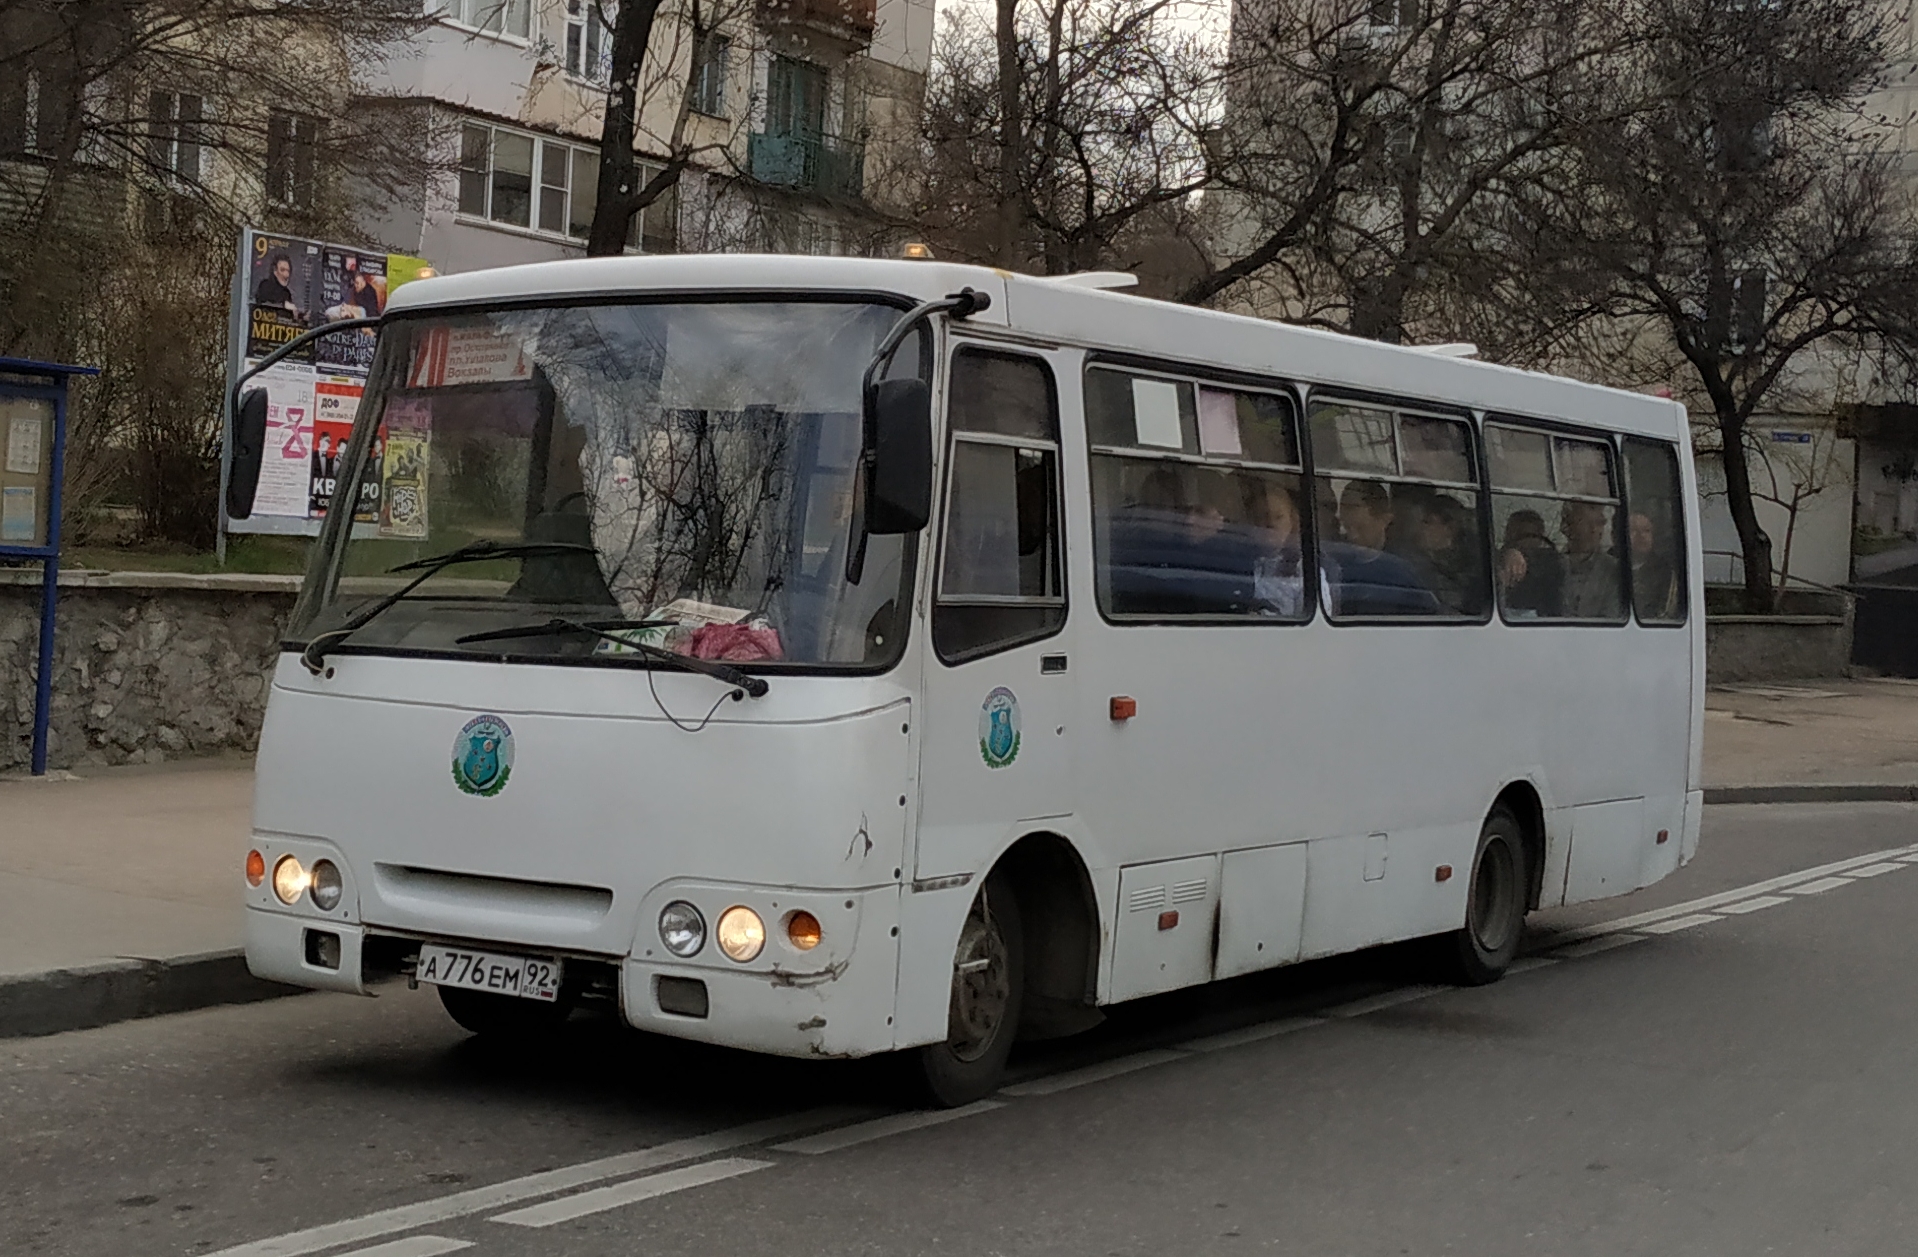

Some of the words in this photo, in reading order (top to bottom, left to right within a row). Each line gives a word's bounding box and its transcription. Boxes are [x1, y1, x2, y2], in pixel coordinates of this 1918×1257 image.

[255, 237, 268, 259] 9
[312, 477, 380, 499] КВРО
[527, 963, 550, 987] 92
[523, 985, 540, 996] RUS
